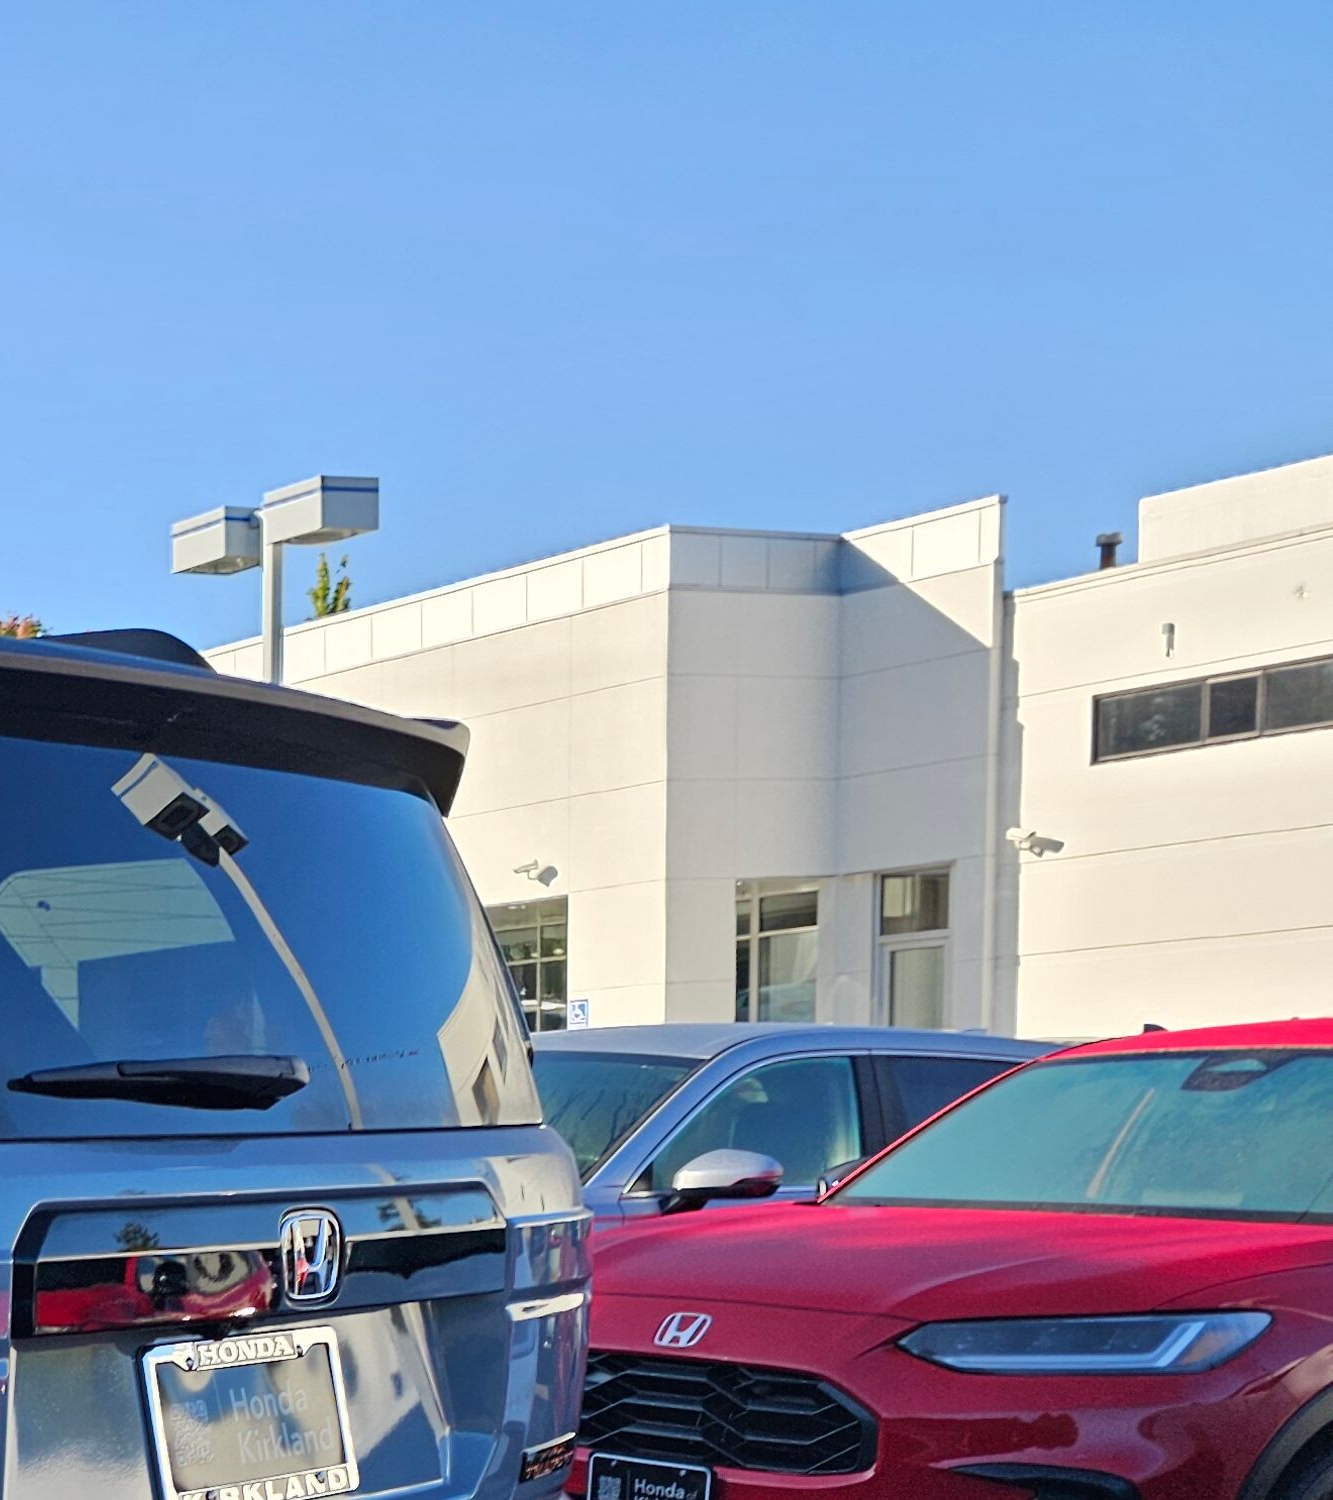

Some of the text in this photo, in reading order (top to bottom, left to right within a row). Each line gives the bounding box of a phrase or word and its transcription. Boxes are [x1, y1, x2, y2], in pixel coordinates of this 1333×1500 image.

[197, 1335, 294, 1367] HONDA
[229, 1379, 309, 1422] Honda
[238, 1416, 334, 1465] Kirkland
[634, 1478, 685, 1500] Honda
